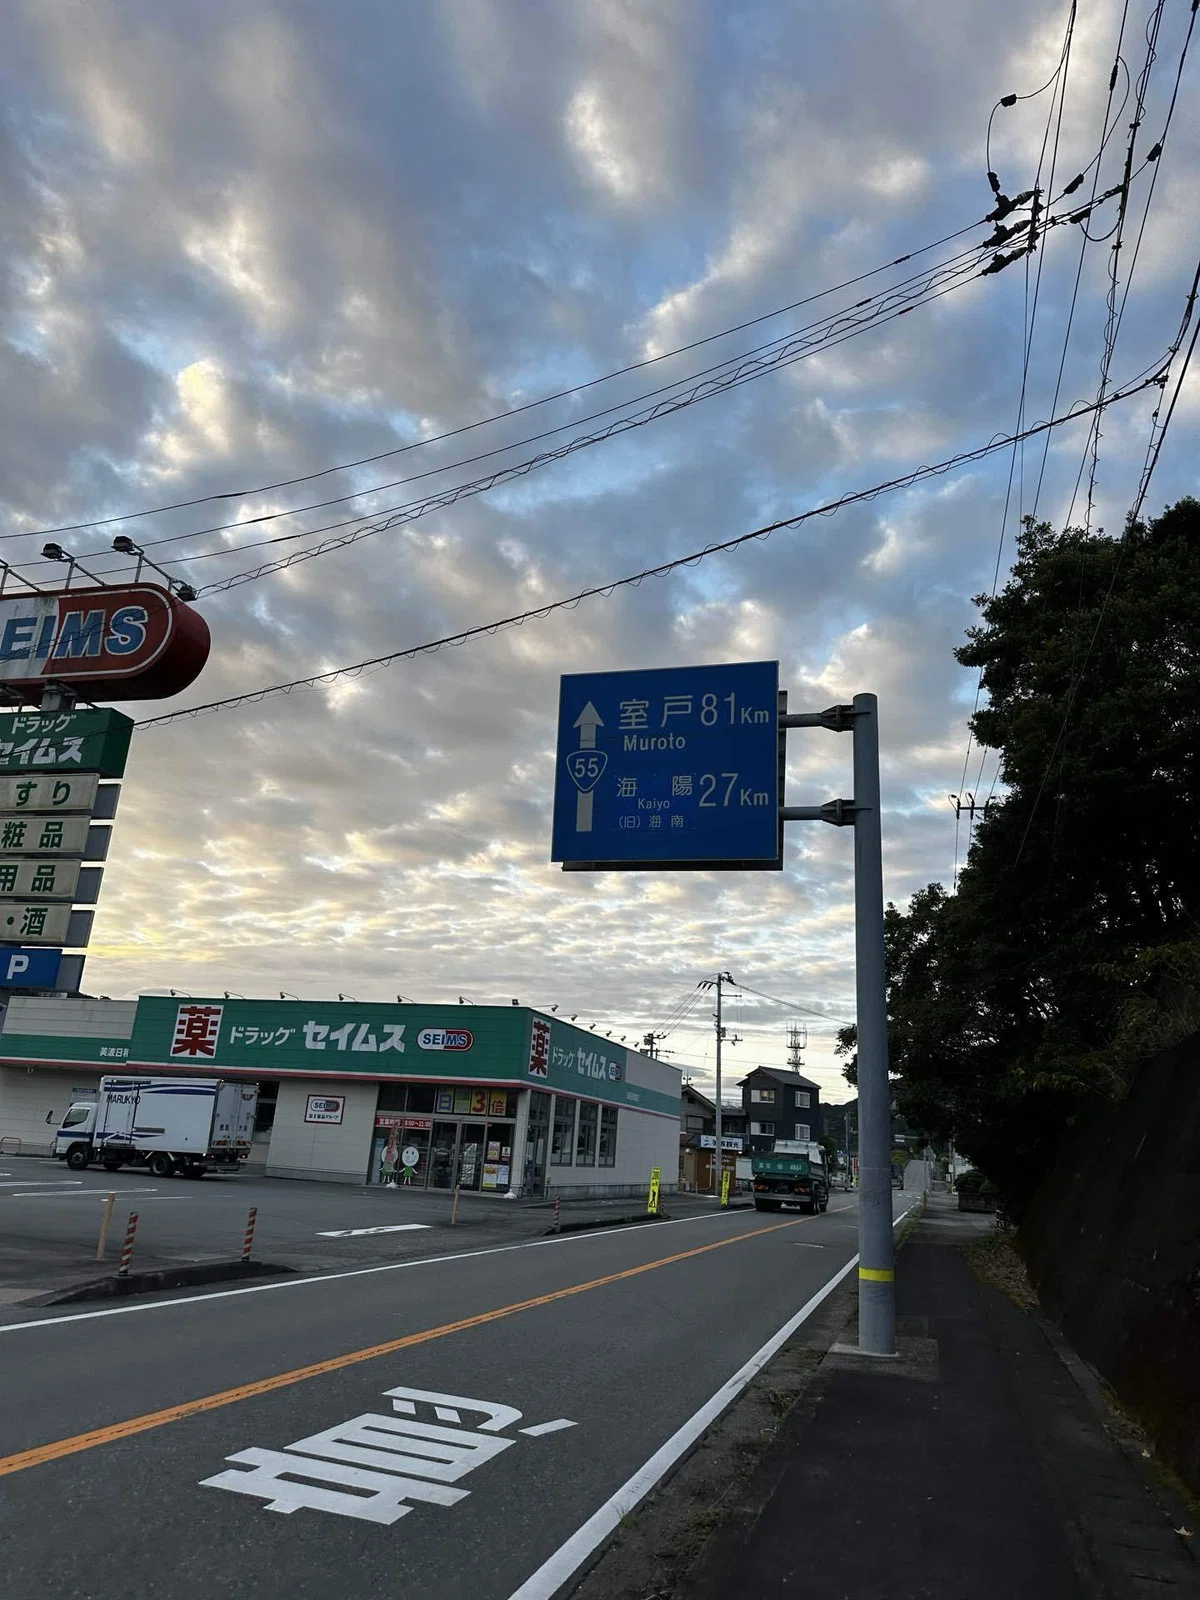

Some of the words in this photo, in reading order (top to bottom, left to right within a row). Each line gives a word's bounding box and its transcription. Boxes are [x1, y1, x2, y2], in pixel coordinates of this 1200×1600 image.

[11, 714, 77, 734] ドラッグ
[618, 695, 693, 730] 室戸
[623, 732, 686, 751] Muroto
[574, 757, 599, 778] 55
[16, 780, 71, 807] すり
[616, 775, 693, 797] 海陽
[637, 798, 670, 810] Kaiyo
[1, 821, 64, 849] 粧品
[7, 954, 30, 980] P
[171, 1005, 222, 1057] 薬
[229, 1026, 296, 1046] ドラッグ
[302, 1020, 407, 1054] セイムス
[422, 1033, 467, 1047] SEIMS
[529, 1020, 551, 1076] 薬
[577, 1047, 607, 1081] セイムス
